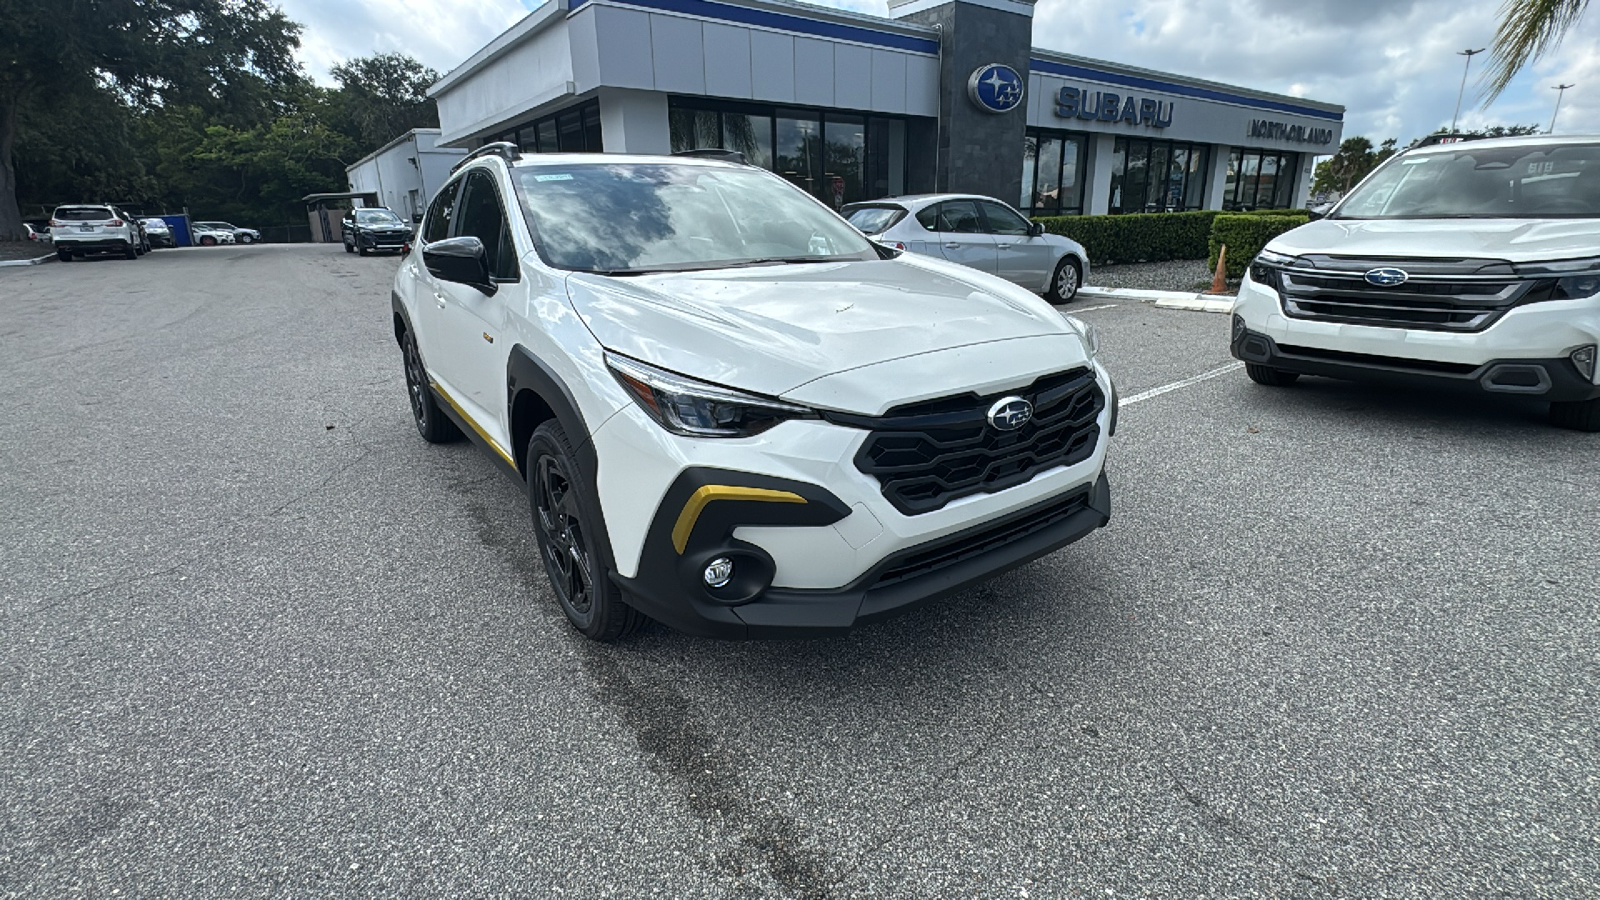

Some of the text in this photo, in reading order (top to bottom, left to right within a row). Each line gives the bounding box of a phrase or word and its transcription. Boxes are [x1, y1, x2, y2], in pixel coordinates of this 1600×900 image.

[1057, 86, 1174, 128] SUBARU
[1250, 119, 1333, 145] NORTH ORLANDO
